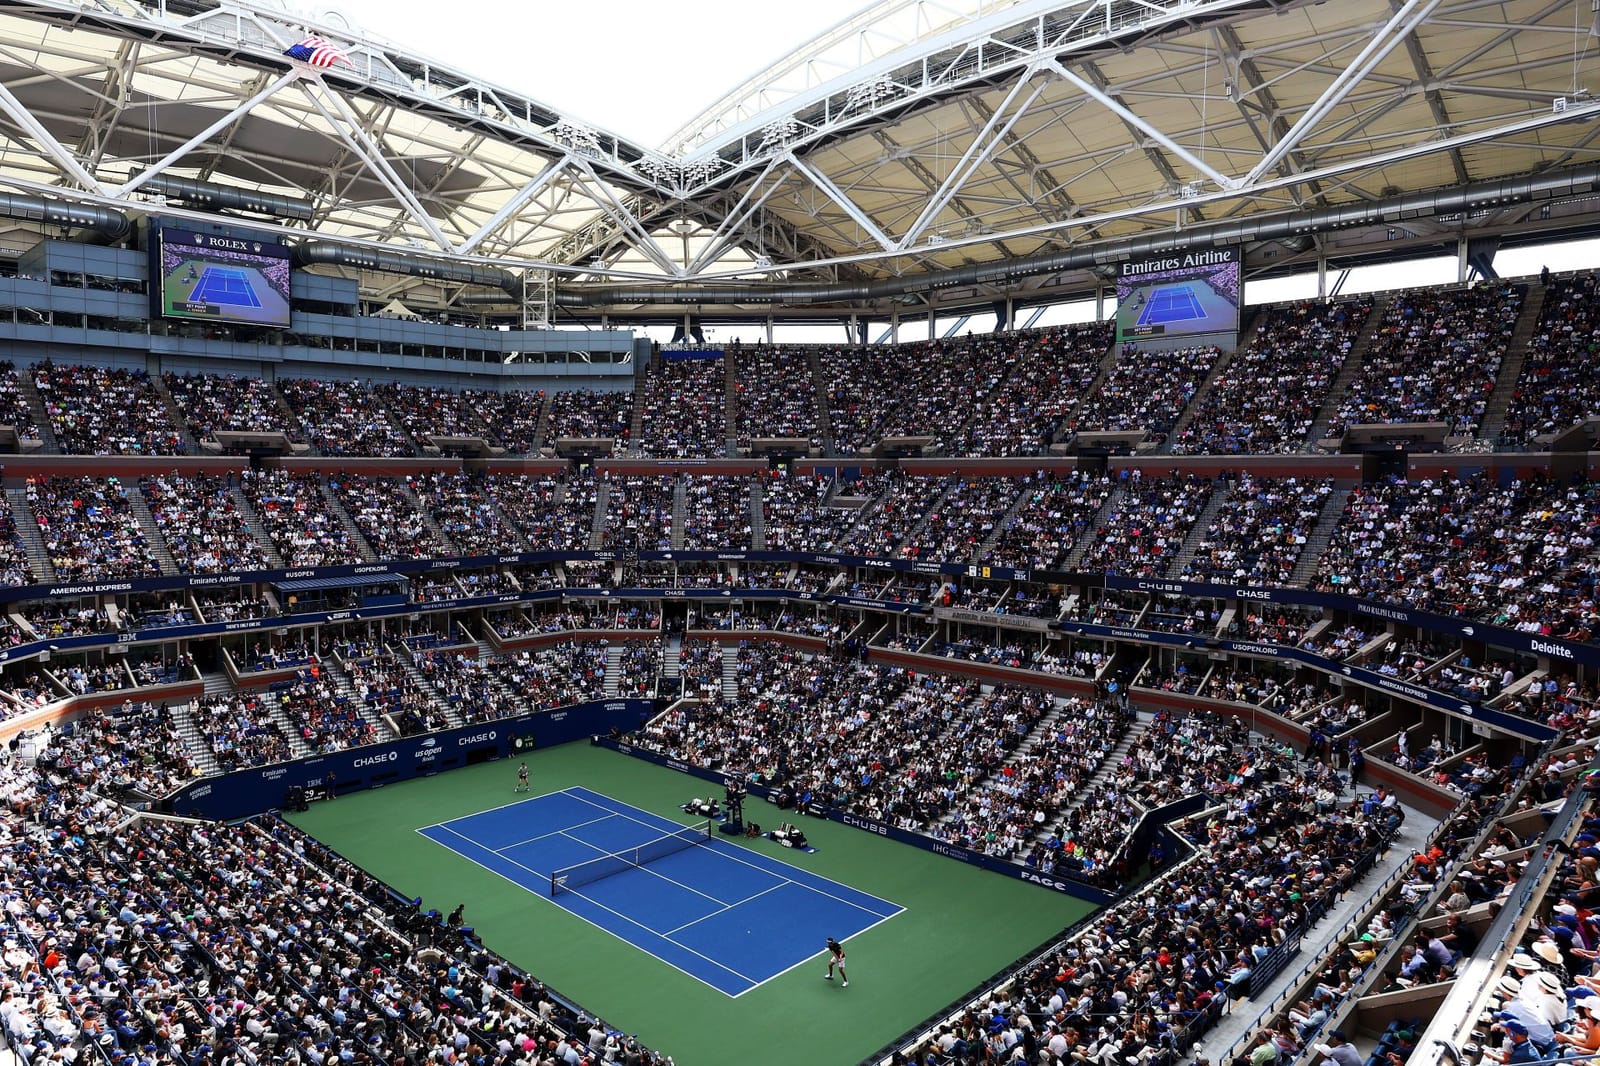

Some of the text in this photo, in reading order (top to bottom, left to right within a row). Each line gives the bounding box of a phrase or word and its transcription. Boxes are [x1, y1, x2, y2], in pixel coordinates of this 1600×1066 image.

[210, 237, 247, 250] ROLEX
[1123, 251, 1231, 276] Emirates Airline
[190, 575, 241, 585] Emirates Airline
[49, 583, 132, 595] AMERICAN EXPRESS
[1138, 582, 1183, 592] CHUBB
[1236, 589, 1271, 599] CHASE
[118, 633, 137, 642] IBM
[1111, 630, 1132, 638] Emirates
[1233, 643, 1278, 655] USOPEN.ORG
[1531, 639, 1574, 659] Deloitte.
[1379, 679, 1428, 699] AMERICAN EXPRESS
[459, 734, 488, 746] CHASE
[353, 754, 388, 768] CHASE
[262, 768, 287, 778] Emirates
[307, 778, 322, 788] IBM
[189, 784, 211, 796] AMERICAN
[191, 790, 212, 800] EXPRESS
[843, 816, 887, 835] CHUBB
[932, 843, 949, 855] IHG
[1021, 871, 1066, 891] FAGE
